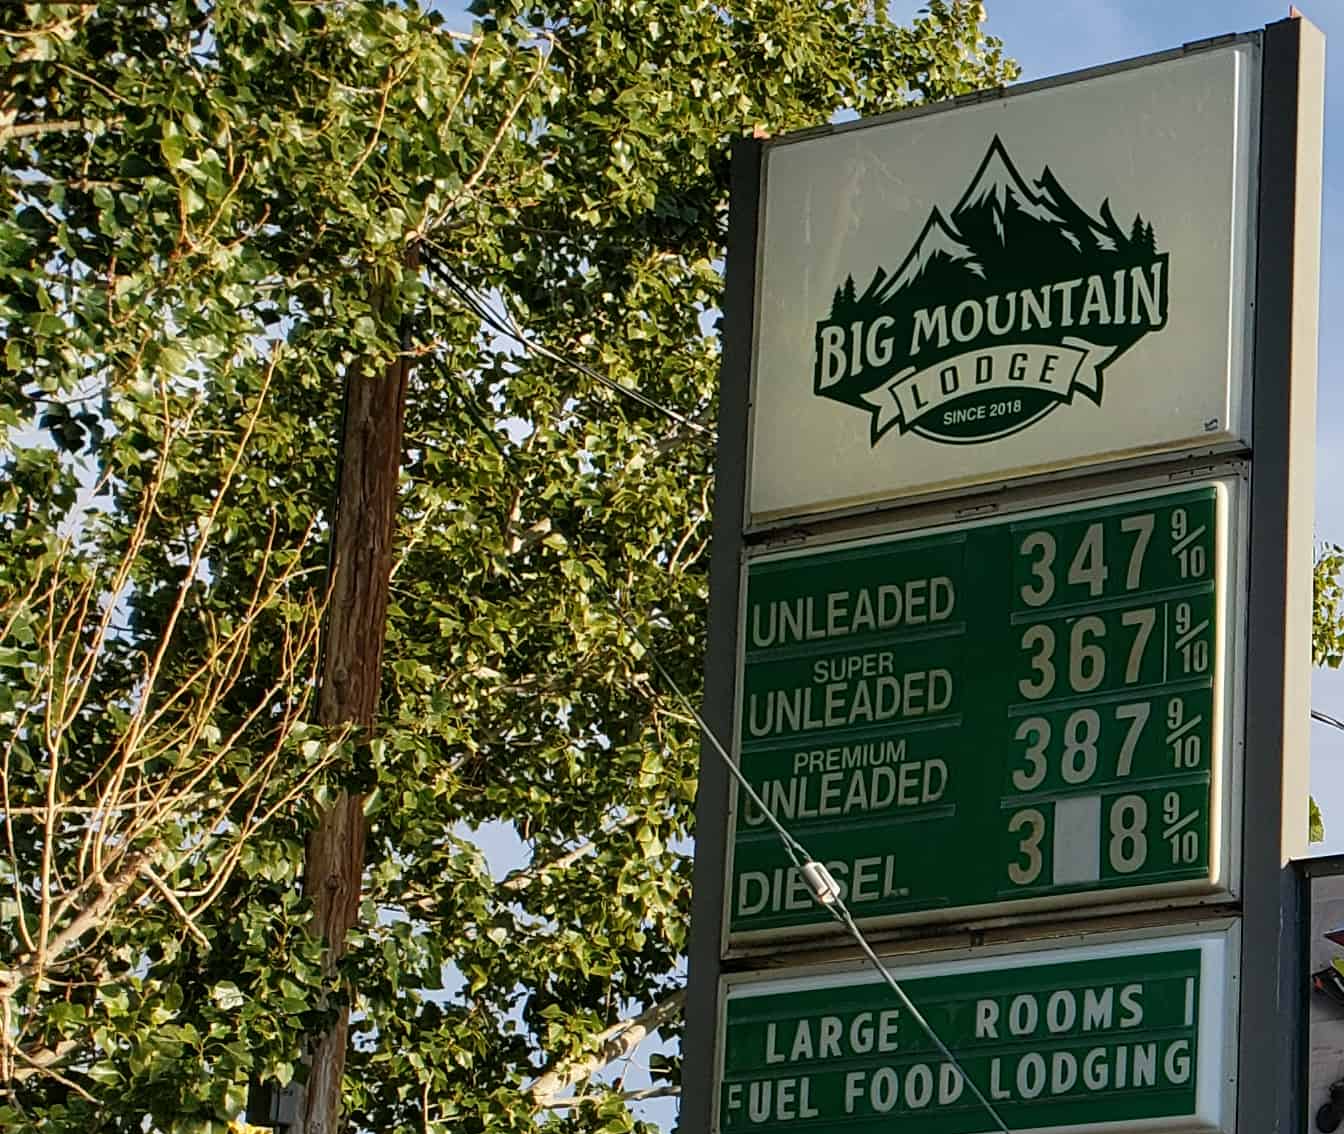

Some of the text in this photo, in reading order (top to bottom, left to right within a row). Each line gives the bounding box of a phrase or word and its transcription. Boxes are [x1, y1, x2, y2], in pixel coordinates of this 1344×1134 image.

[819, 260, 1164, 390] BIG MOUNTAIN
[911, 353, 1059, 410] LODGE
[943, 400, 1022, 426] SINCE 2018
[1020, 513, 1155, 607] 347
[752, 576, 955, 647] UNLEADED
[813, 651, 894, 684] SUPER
[1018, 608, 1156, 700] 367
[749, 669, 953, 737] UNLEADED
[793, 739, 906, 775] PREMIUM
[1012, 702, 1152, 791] 387
[744, 758, 948, 826] UNLEADED
[738, 855, 910, 917] DIESEL
[766, 1008, 899, 1065] LARGE
[975, 984, 1144, 1040] ROOMS
[727, 1039, 1191, 1126] FUEL FOOD LODGING
